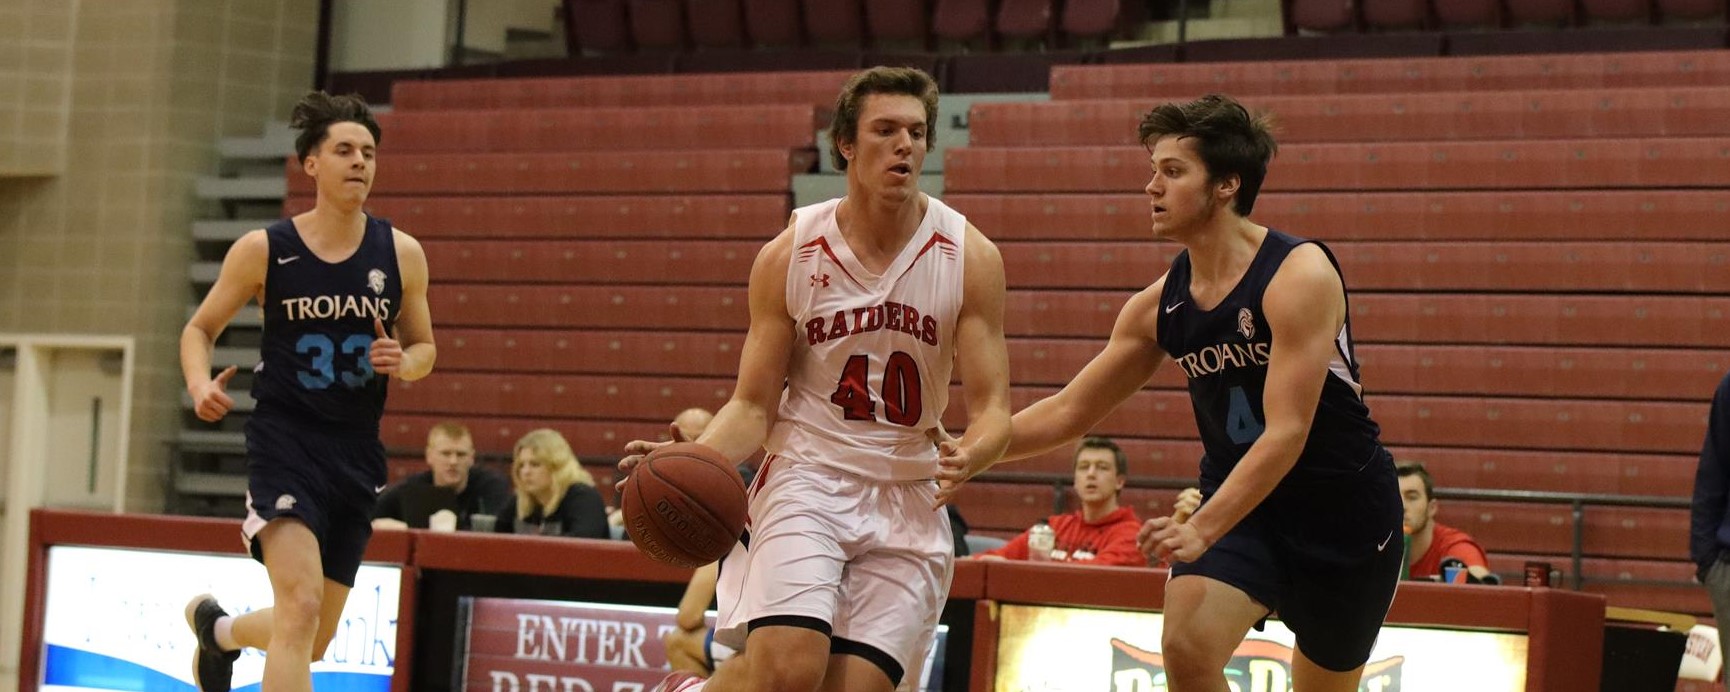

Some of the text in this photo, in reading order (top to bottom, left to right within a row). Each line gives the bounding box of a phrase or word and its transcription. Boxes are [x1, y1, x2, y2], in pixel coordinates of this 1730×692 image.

[282, 295, 391, 321] TROJANS
[805, 301, 938, 346] RAIDERS
[296, 333, 375, 390] 33
[1175, 342, 1270, 378] TROJANS
[831, 351, 922, 427] 40
[1225, 385, 1266, 445] 4
[514, 613, 649, 669] ENTER
